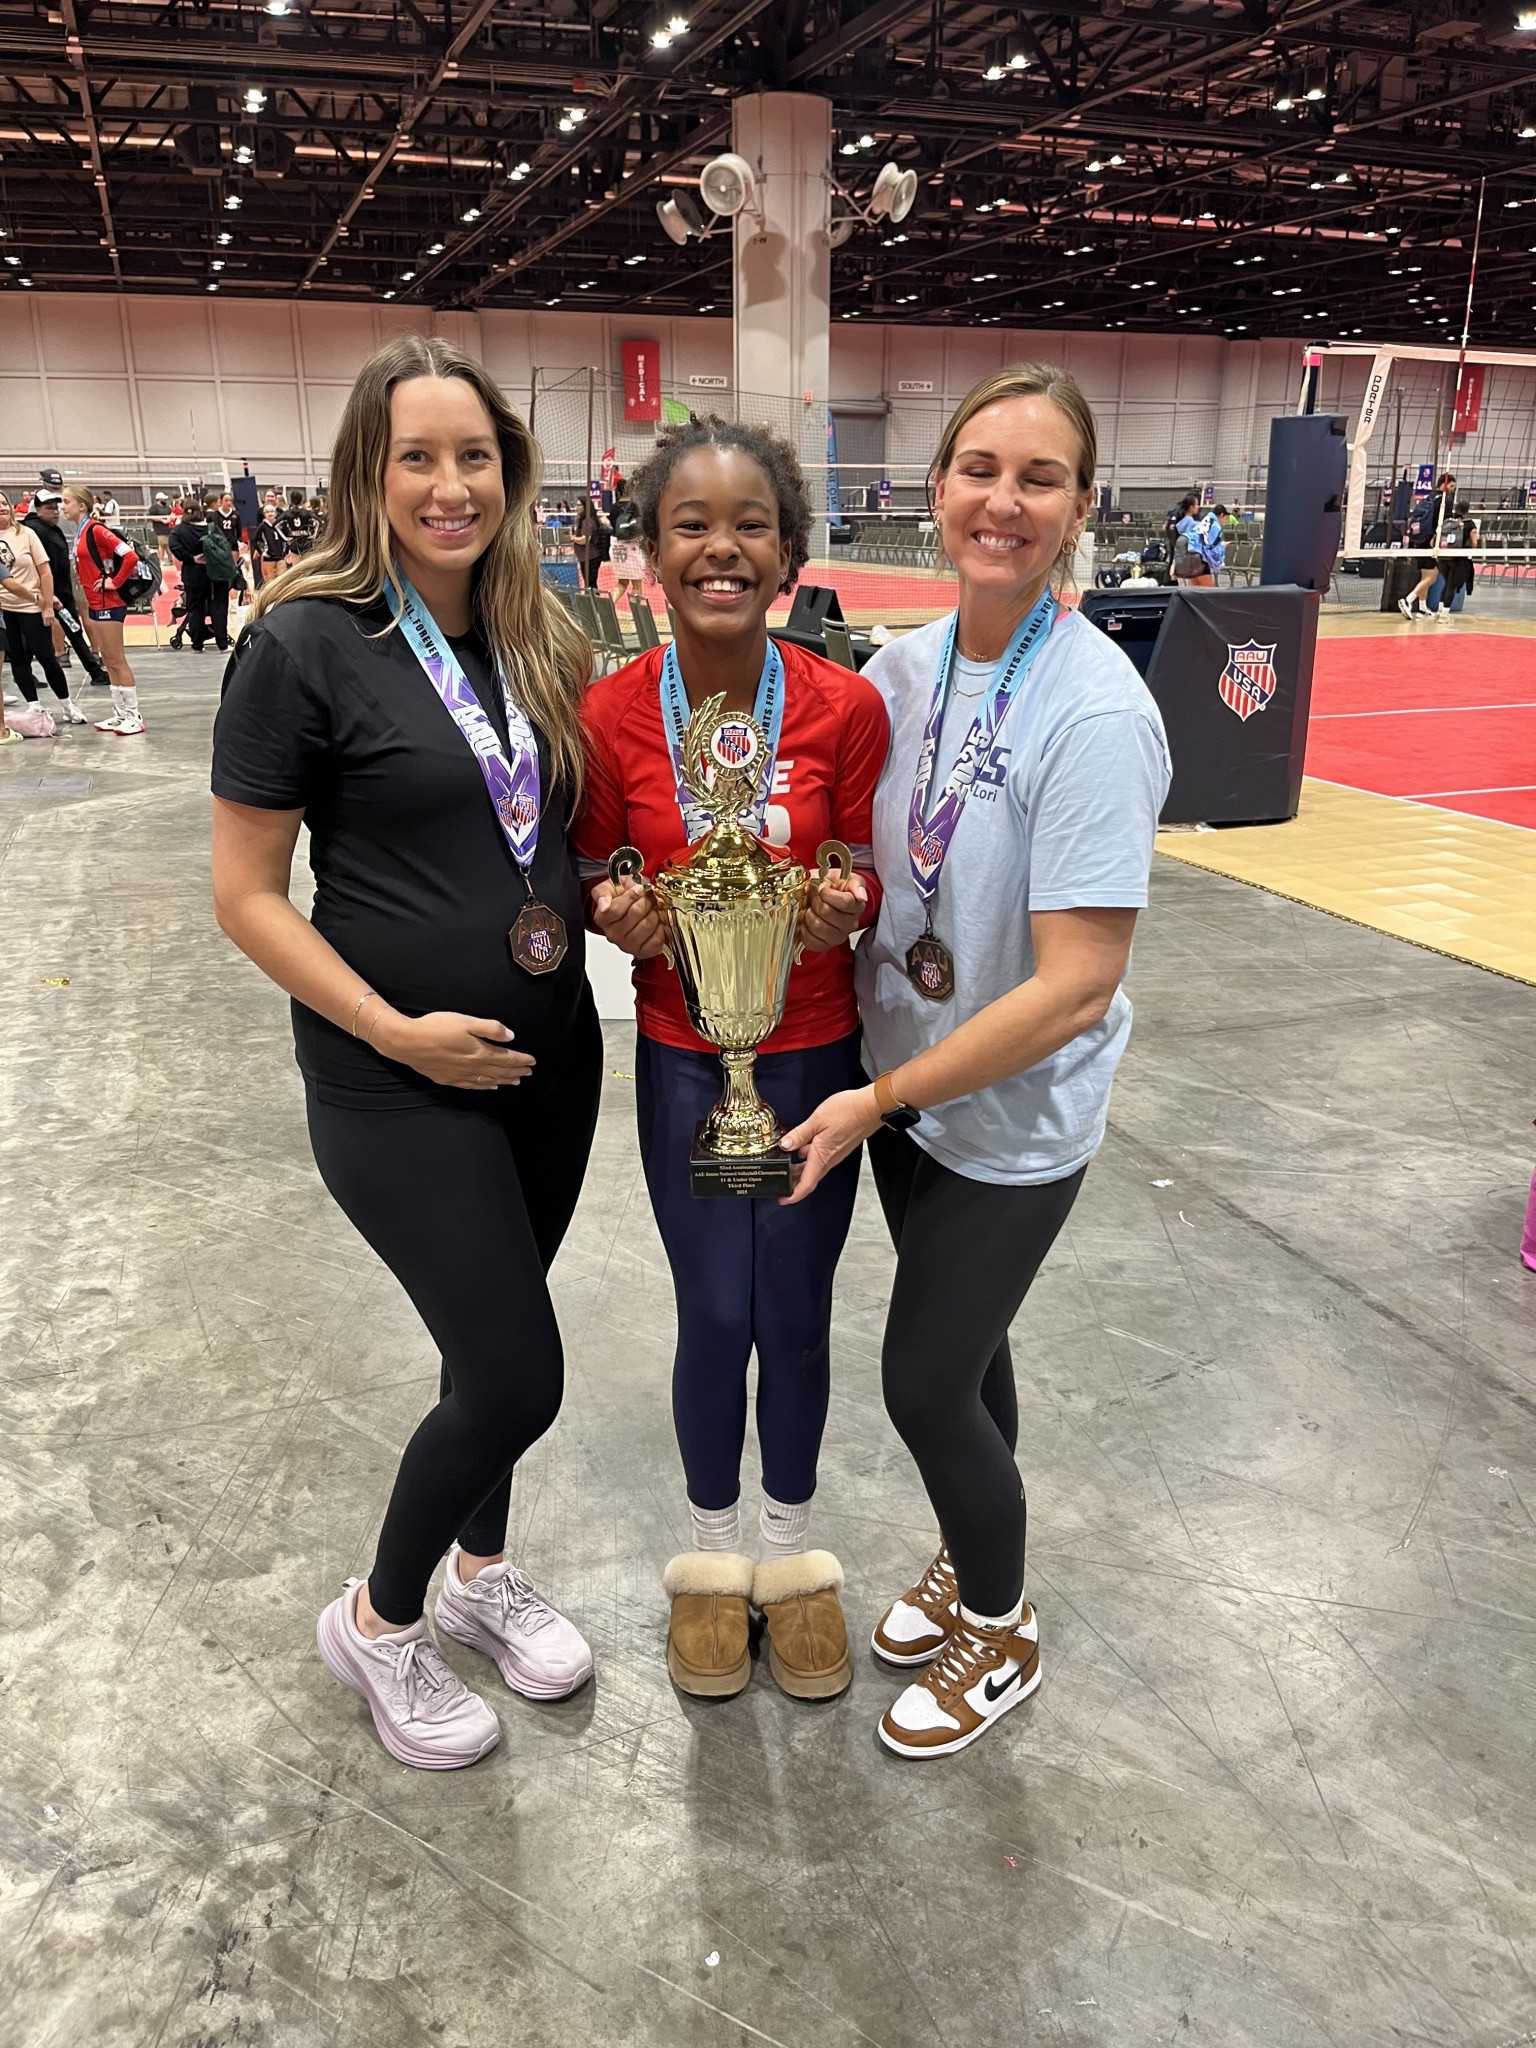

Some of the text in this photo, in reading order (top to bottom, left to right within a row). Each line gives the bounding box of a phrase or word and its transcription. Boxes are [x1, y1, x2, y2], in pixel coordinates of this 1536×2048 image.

[637, 354, 645, 402] MEDICAL
[698, 377, 724, 385] NORTH
[1363, 375, 1382, 424] PORTER
[1465, 378, 1474, 417] MEDICAL
[222, 520, 232, 529] 22
[413, 618, 440, 659] FOREVER
[998, 655, 1021, 695] SPORTS
[1017, 634, 1034, 655] FOR
[1236, 652, 1266, 661] AAU
[766, 687, 775, 707] FOR
[1233, 667, 1260, 701] USA
[667, 661, 675, 681] FOR
[671, 706, 684, 746] FOREVE
[452, 704, 501, 757] AAU
[724, 738, 742, 757] USA
[945, 726, 992, 804] 2025
[972, 784, 998, 802] Lori
[517, 913, 559, 945] AAU
[911, 945, 948, 972] AAU
